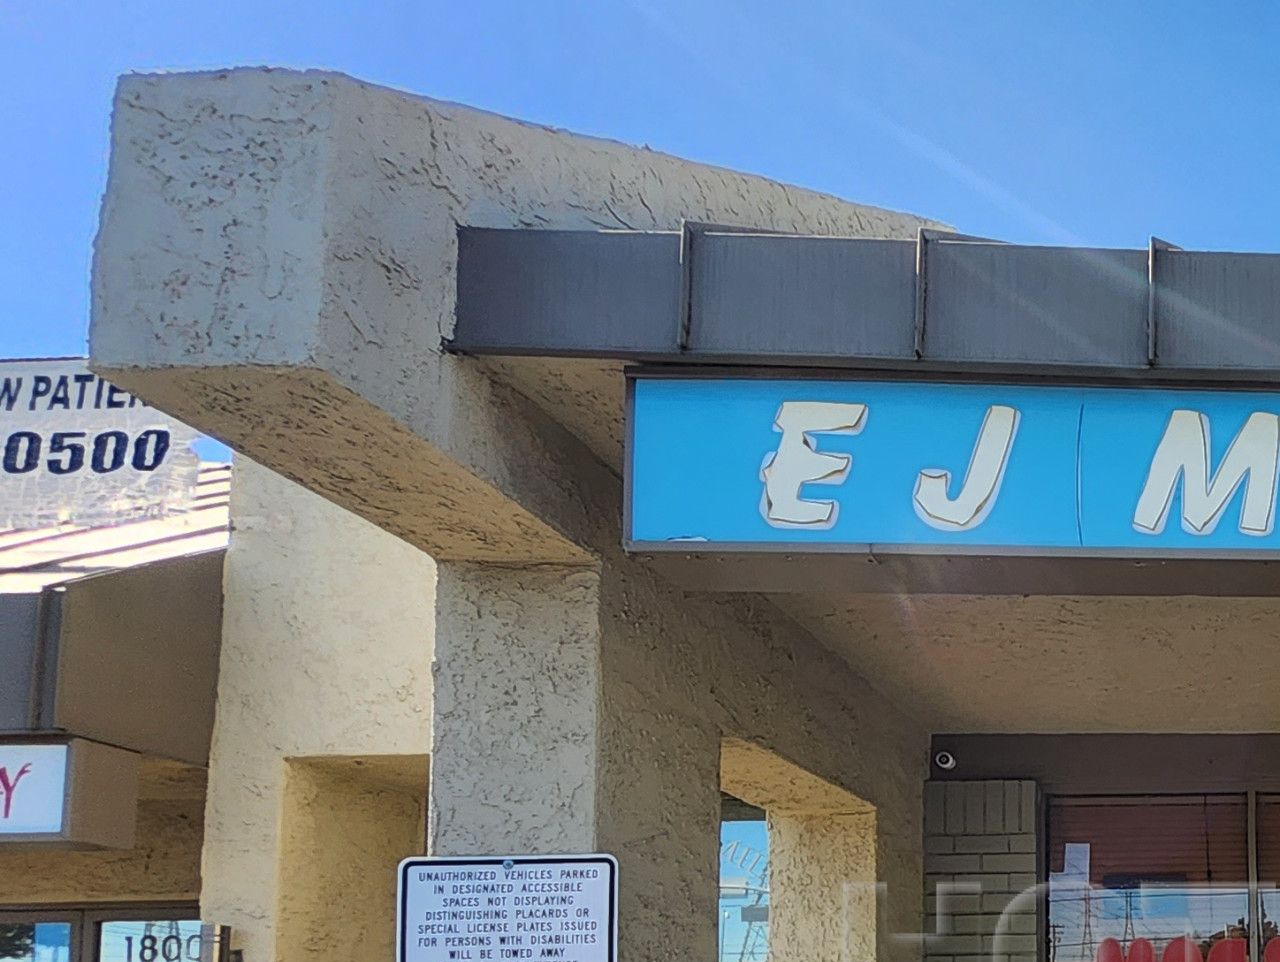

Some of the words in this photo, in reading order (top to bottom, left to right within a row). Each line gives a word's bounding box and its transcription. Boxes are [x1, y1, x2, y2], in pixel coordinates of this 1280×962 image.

[3, 429, 170, 475] 0500
[759, 400, 869, 531] E
[912, 403, 1022, 533] J
[419, 871, 497, 882] UNAUTHORIZED
[504, 869, 553, 880] VEHICLES
[560, 869, 599, 879] PARKED
[433, 884, 445, 894] IN
[452, 883, 514, 894] DESIGNATED
[521, 882, 583, 893] ACCESSIBLE
[442, 897, 480, 908] SPACES
[487, 896, 507, 907] NOT
[514, 895, 574, 906] DISPLAYING
[425, 910, 508, 921] DISTINGUISHING
[515, 909, 568, 919] PLACARDS
[576, 908, 589, 918] OR
[418, 924, 460, 935] SPECIAL
[467, 923, 509, 934] LICENSE
[516, 922, 553, 932] PLATES
[560, 921, 598, 931] ISSUED
[418, 937, 437, 947] FOR
[445, 936, 492, 946] PERSONS
[499, 935, 522, 945] WITH
[530, 934, 597, 945] DISABILITIES
[449, 950, 472, 959] WILL
[480, 950, 493, 959] BE
[500, 949, 533, 959] TOWED
[540, 948, 566, 958] AWAY
